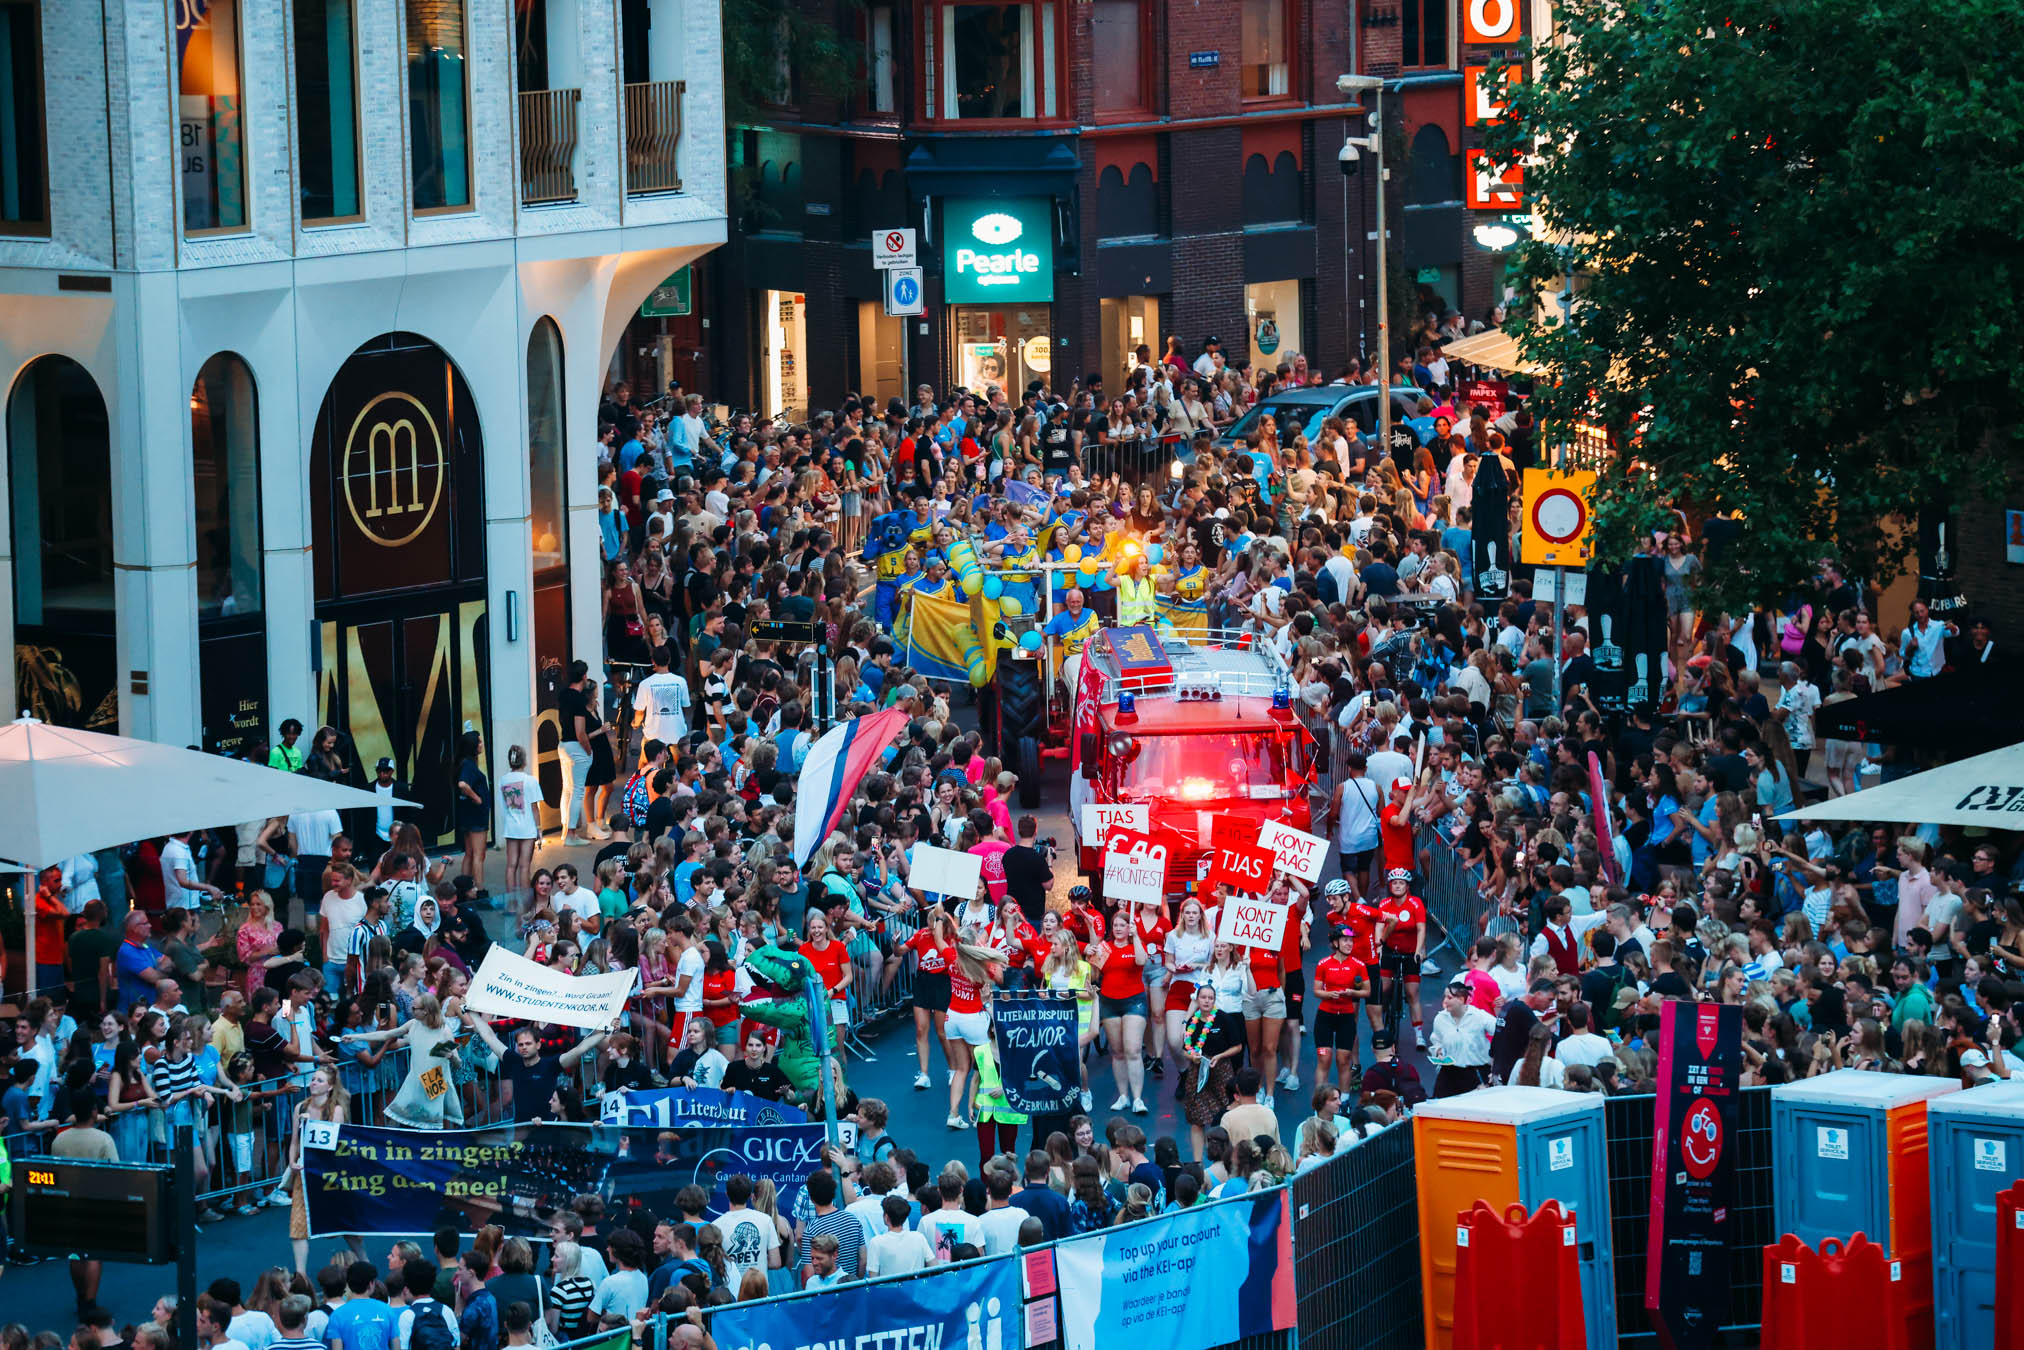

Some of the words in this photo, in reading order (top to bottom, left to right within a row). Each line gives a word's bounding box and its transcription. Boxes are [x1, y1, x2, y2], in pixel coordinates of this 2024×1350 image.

[957, 249, 1040, 273] Pearle
[1470, 389, 1497, 398] IMPEX
[240, 701, 258, 711] Hier
[233, 715, 259, 728] wordt
[1096, 810, 1134, 824] TJAS
[1273, 832, 1316, 856] KONT
[1222, 849, 1264, 878] TJAS
[1105, 864, 1163, 888] #KONTEST
[1236, 906, 1277, 925] KONT
[1233, 922, 1273, 943] LAAG
[498, 972, 512, 983] Zin
[514, 978, 523, 988] in
[486, 983, 609, 1012] WWW.STUDENTENKOOR.NL
[997, 1010, 1036, 1022] LITERAIR
[1038, 1009, 1075, 1021] DISPUUT
[421, 1068, 443, 1083] FLA
[425, 1080, 446, 1098] NOR
[603, 1099, 620, 1115] 14
[1005, 1088, 1020, 1102] 25
[1018, 1099, 1059, 1112] FEBRUARI
[1062, 1086, 1080, 1108] 1986
[308, 1129, 331, 1145] 13
[335, 1140, 378, 1160] Zin
[385, 1140, 413, 1160] in
[420, 1140, 523, 1169] zingen?
[322, 1170, 386, 1196] Zing
[444, 1176, 508, 1196] mee!
[1120, 1247, 1138, 1262] Top
[1142, 1241, 1156, 1257] up
[1158, 1237, 1178, 1257] your
[1123, 1268, 1138, 1284] via
[1140, 1264, 1154, 1280] the
[1122, 1294, 1156, 1311] Waardeer
[1157, 1292, 1165, 1305] je
[1121, 1316, 1132, 1328] op
[1133, 1312, 1144, 1323] via
[1145, 1309, 1155, 1320] de
